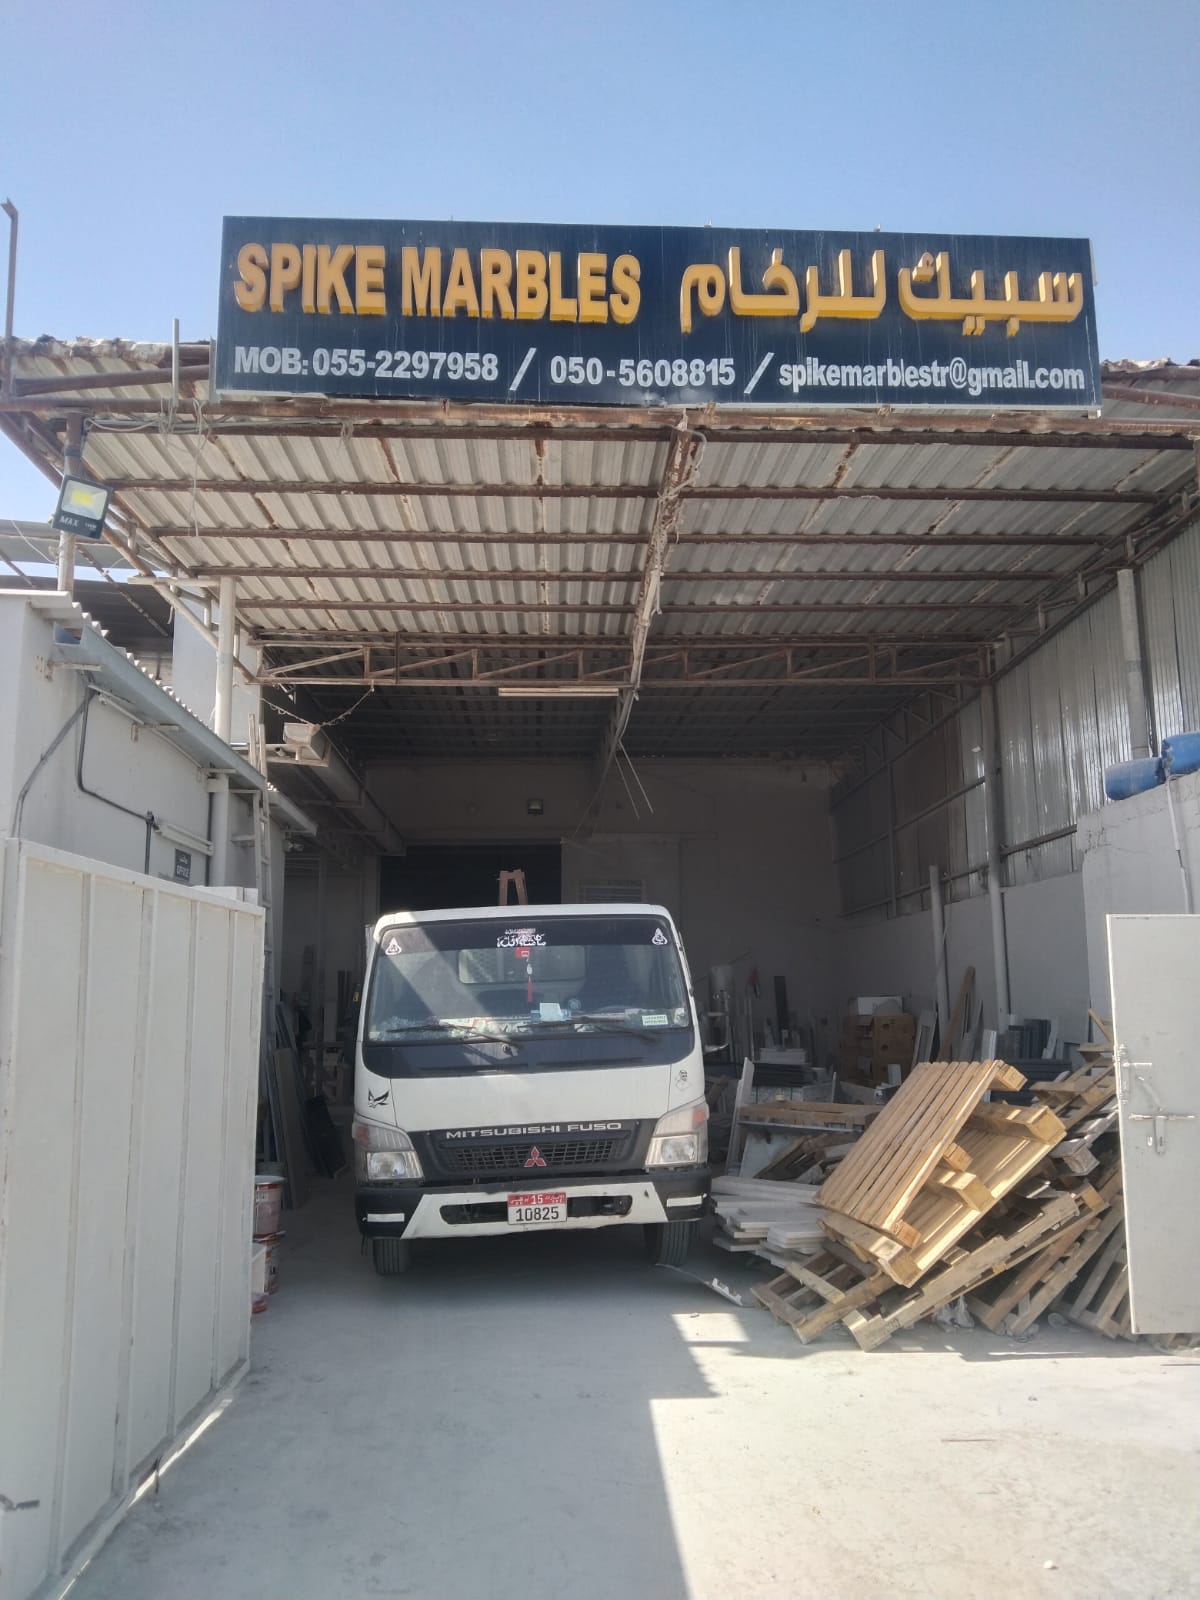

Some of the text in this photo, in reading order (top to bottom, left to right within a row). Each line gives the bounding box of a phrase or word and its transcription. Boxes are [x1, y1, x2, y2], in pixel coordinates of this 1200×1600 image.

[234, 243, 641, 325] SPIKE MARBLES
[680, 246, 1083, 336] سبيك للرخام
[550, 355, 736, 388] 050-5608815
[779, 356, 1085, 396] spikemarblestr@gmail.com
[446, 1122, 622, 1139] MITSUBISHI FUSO
[515, 1206, 559, 1222] 10825
[531, 1194, 543, 1205] 15
